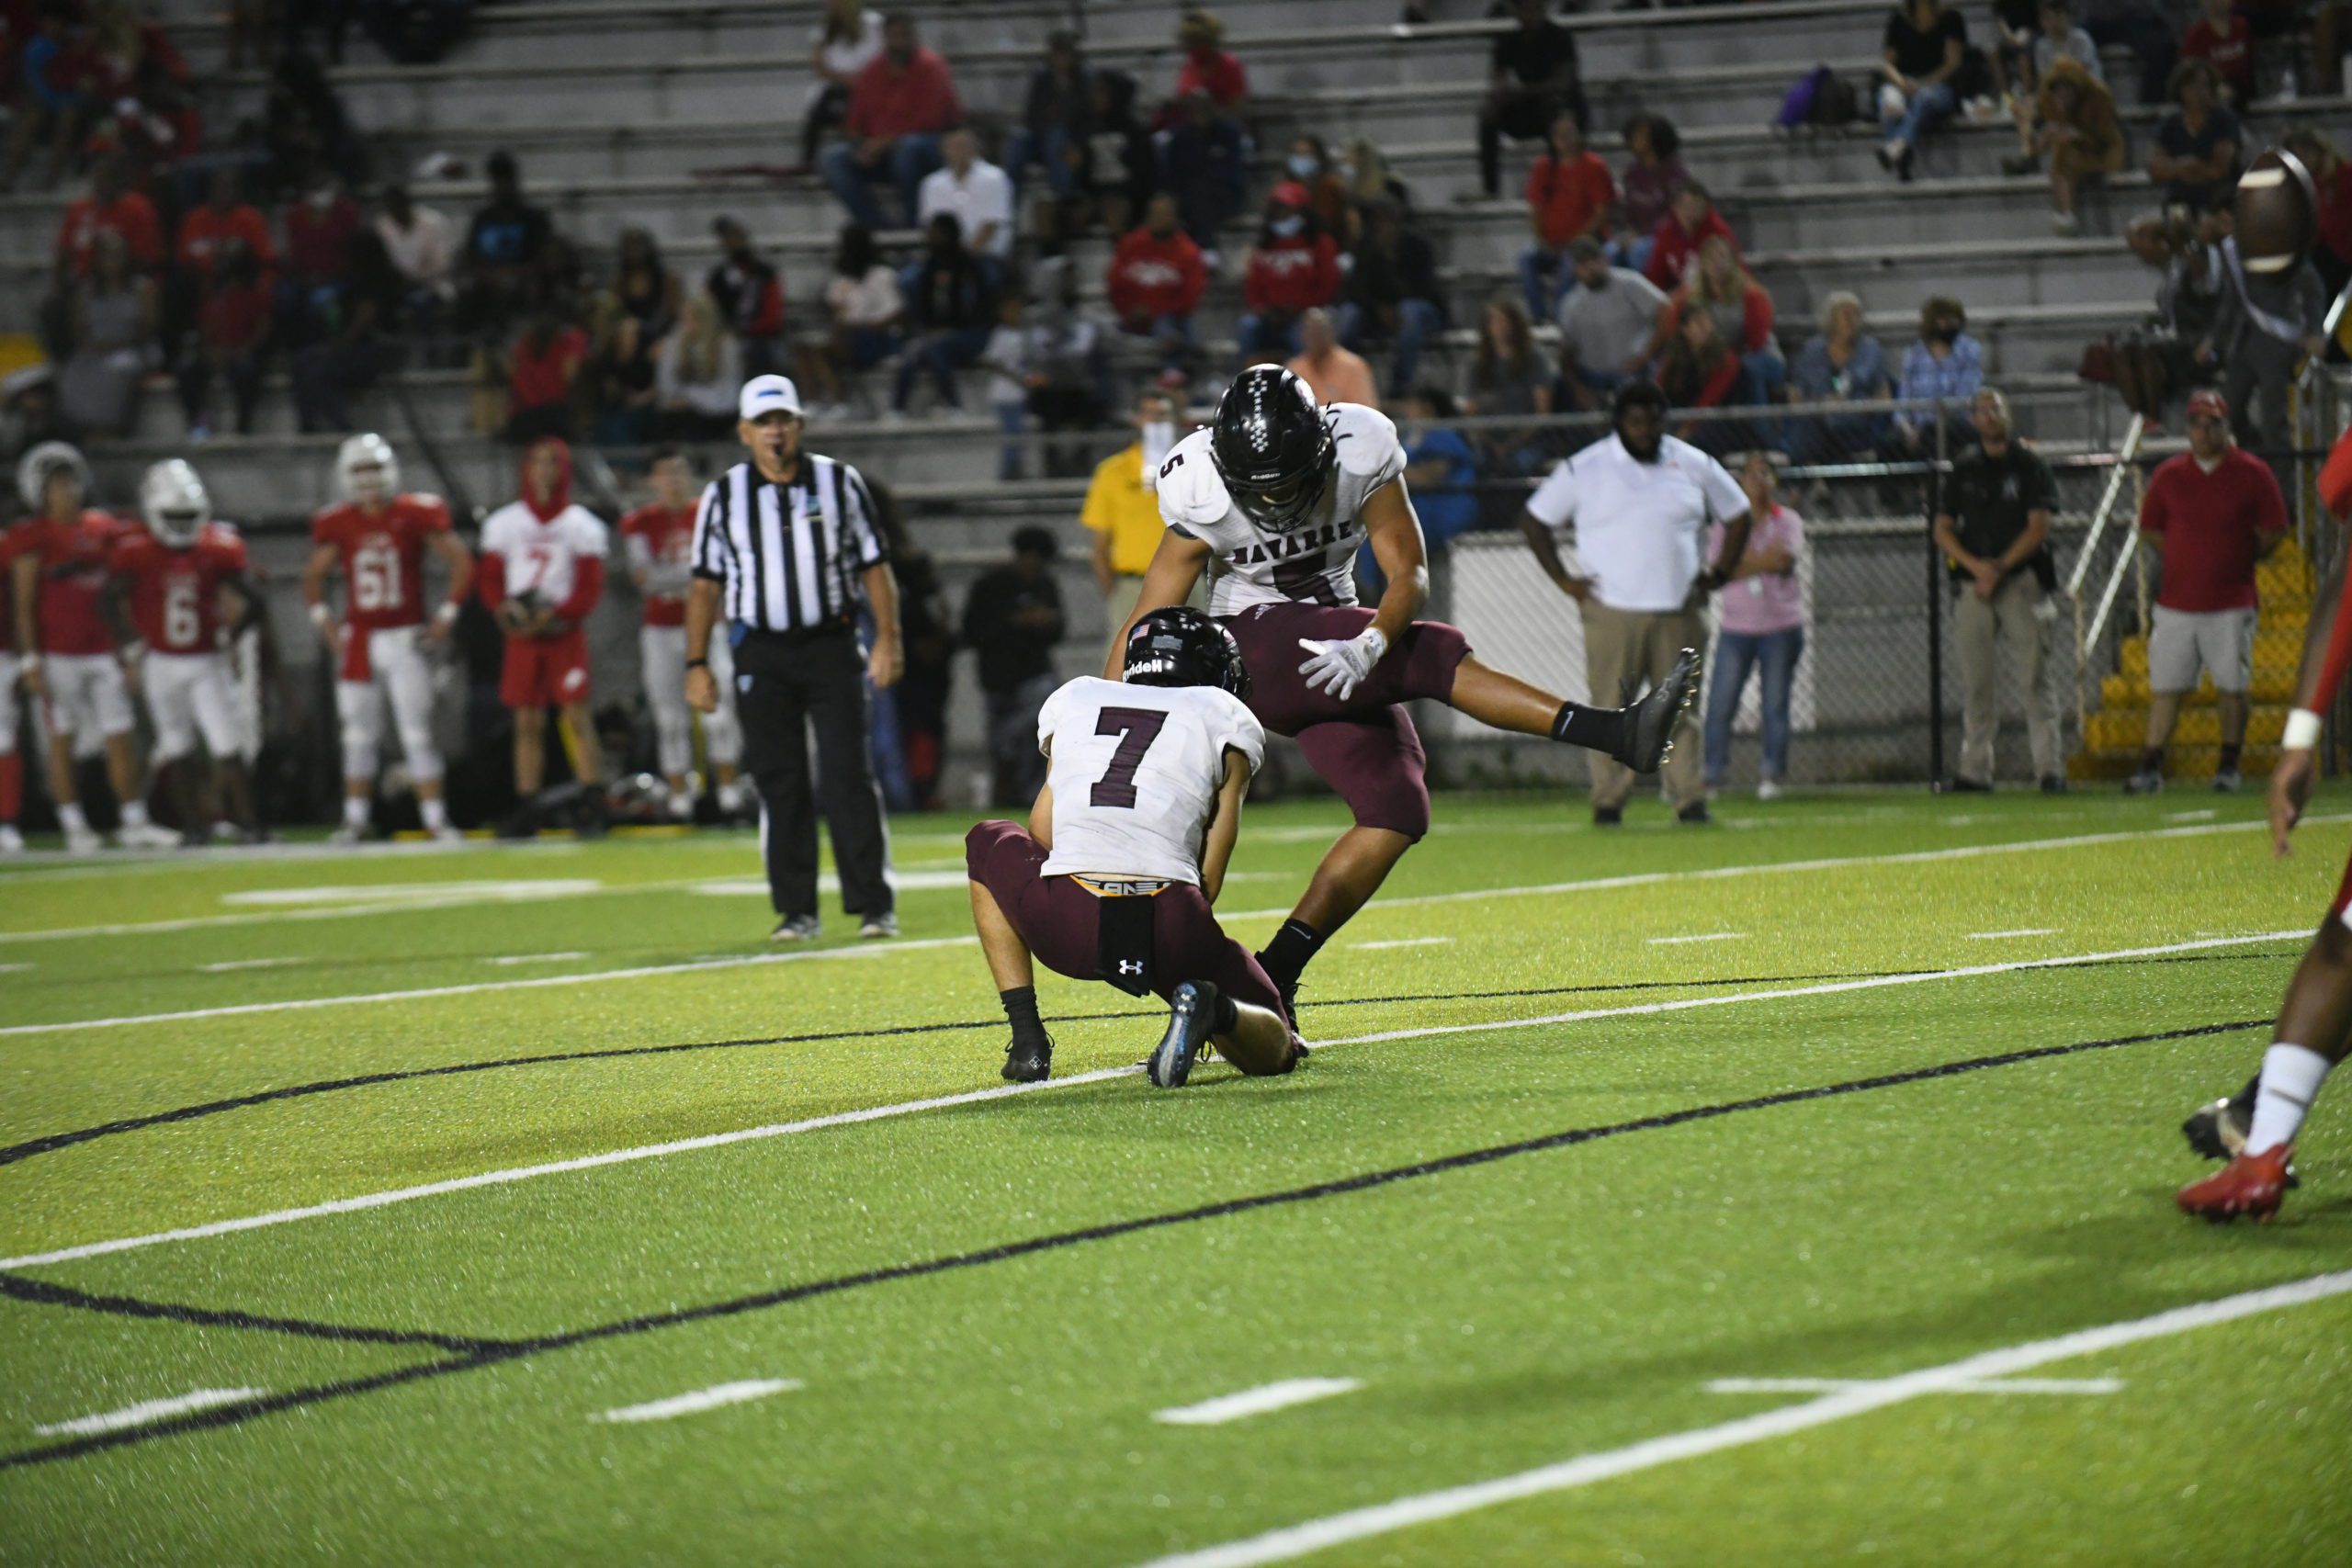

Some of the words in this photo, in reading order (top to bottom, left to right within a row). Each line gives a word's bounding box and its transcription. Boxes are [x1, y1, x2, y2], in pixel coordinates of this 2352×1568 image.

[1159, 454, 1185, 479] 5
[164, 586, 200, 646] 6
[1090, 706, 1170, 809] 7
